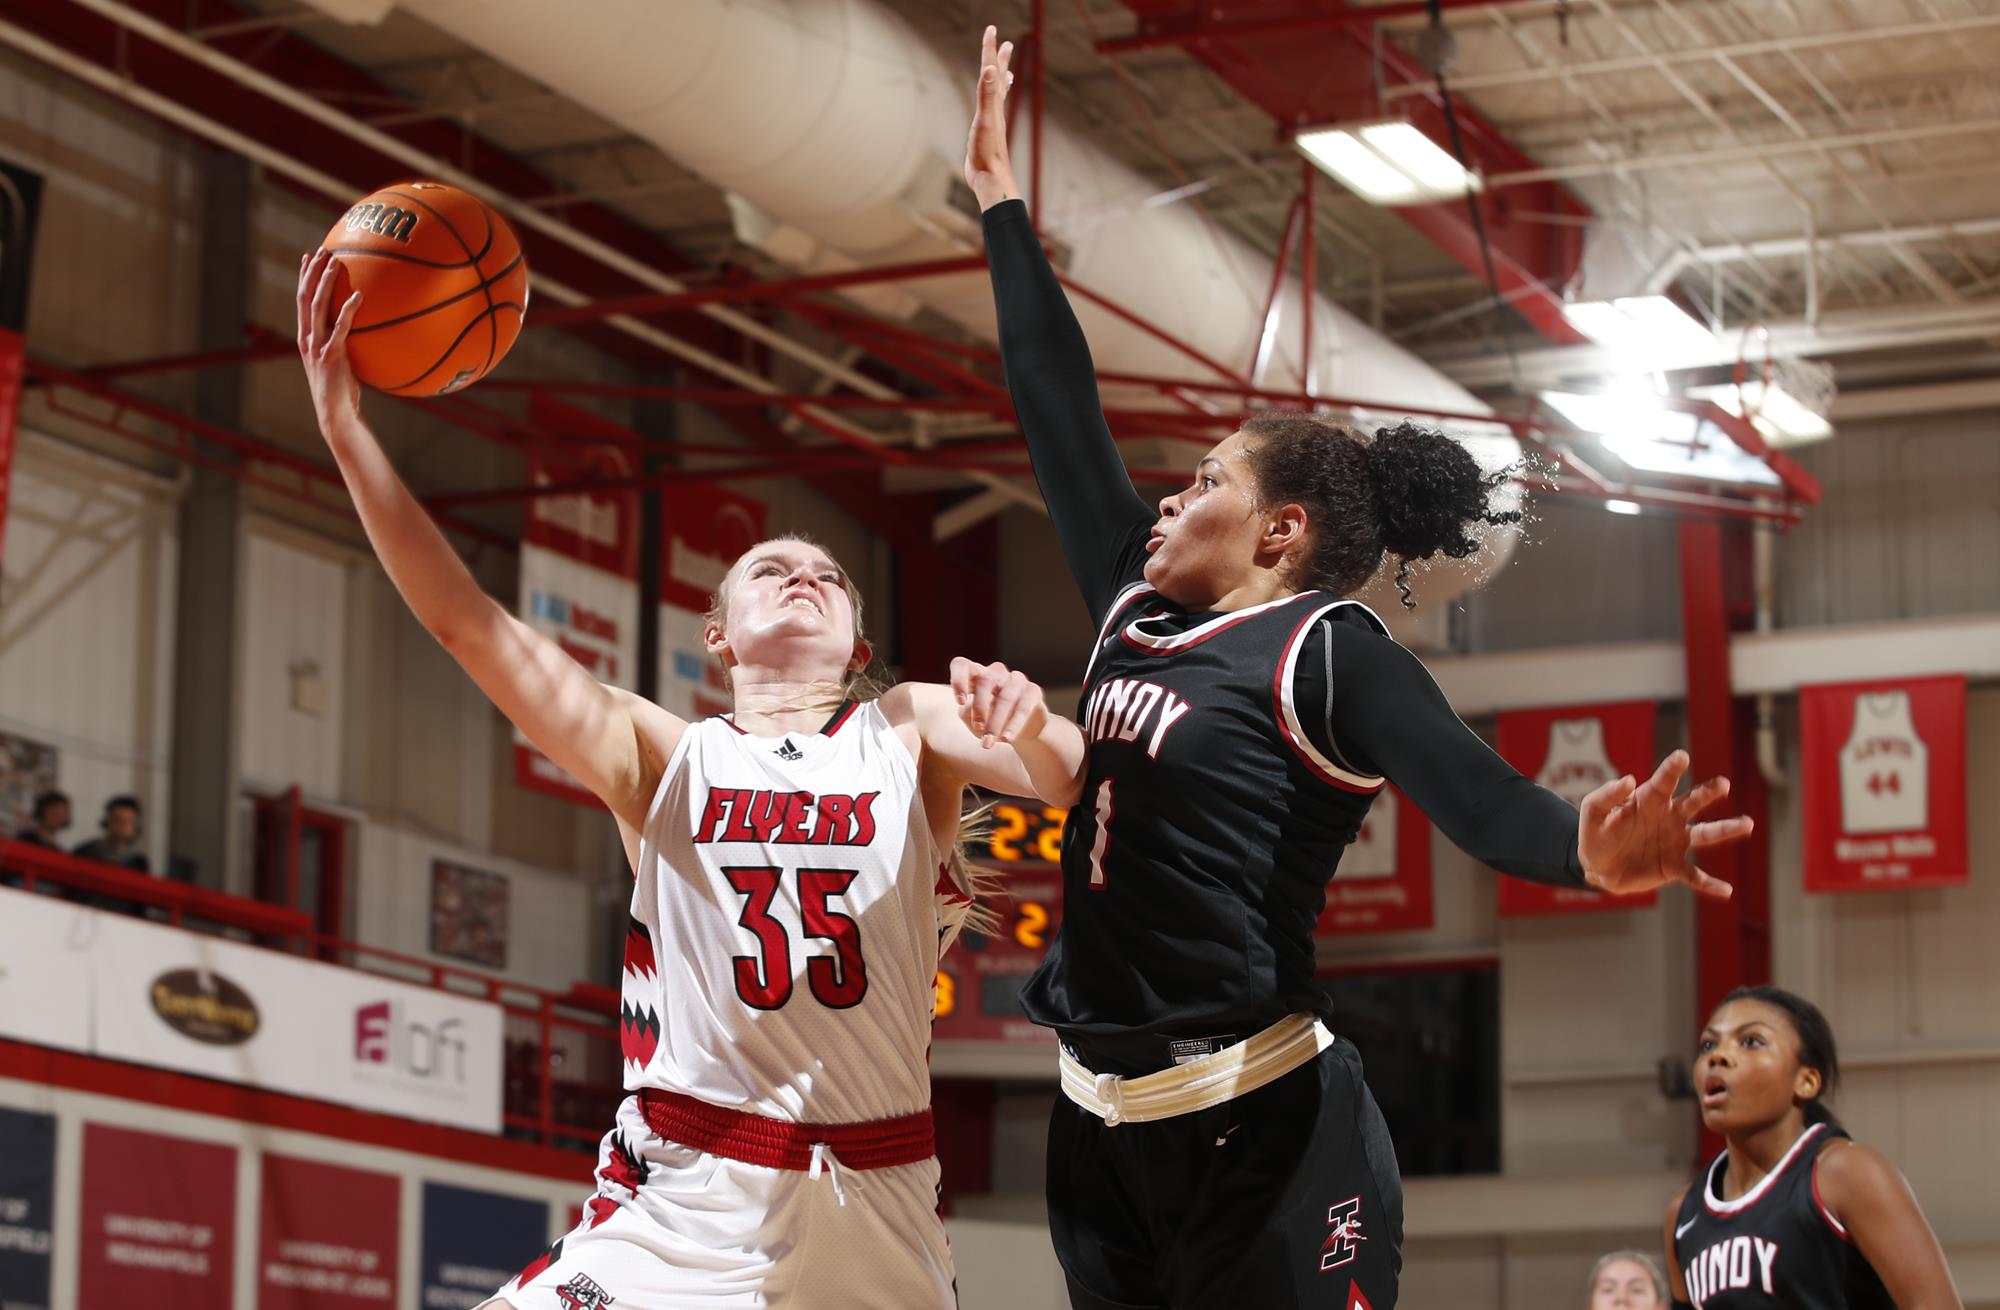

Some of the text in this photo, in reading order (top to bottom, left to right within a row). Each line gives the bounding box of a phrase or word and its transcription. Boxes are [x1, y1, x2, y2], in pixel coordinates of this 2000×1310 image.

[1866, 771, 1901, 799] 44
[693, 786, 881, 847] FLYERS
[1088, 776, 1115, 891] 1
[720, 865, 868, 1011] 35
[1015, 902, 1048, 948] 2
